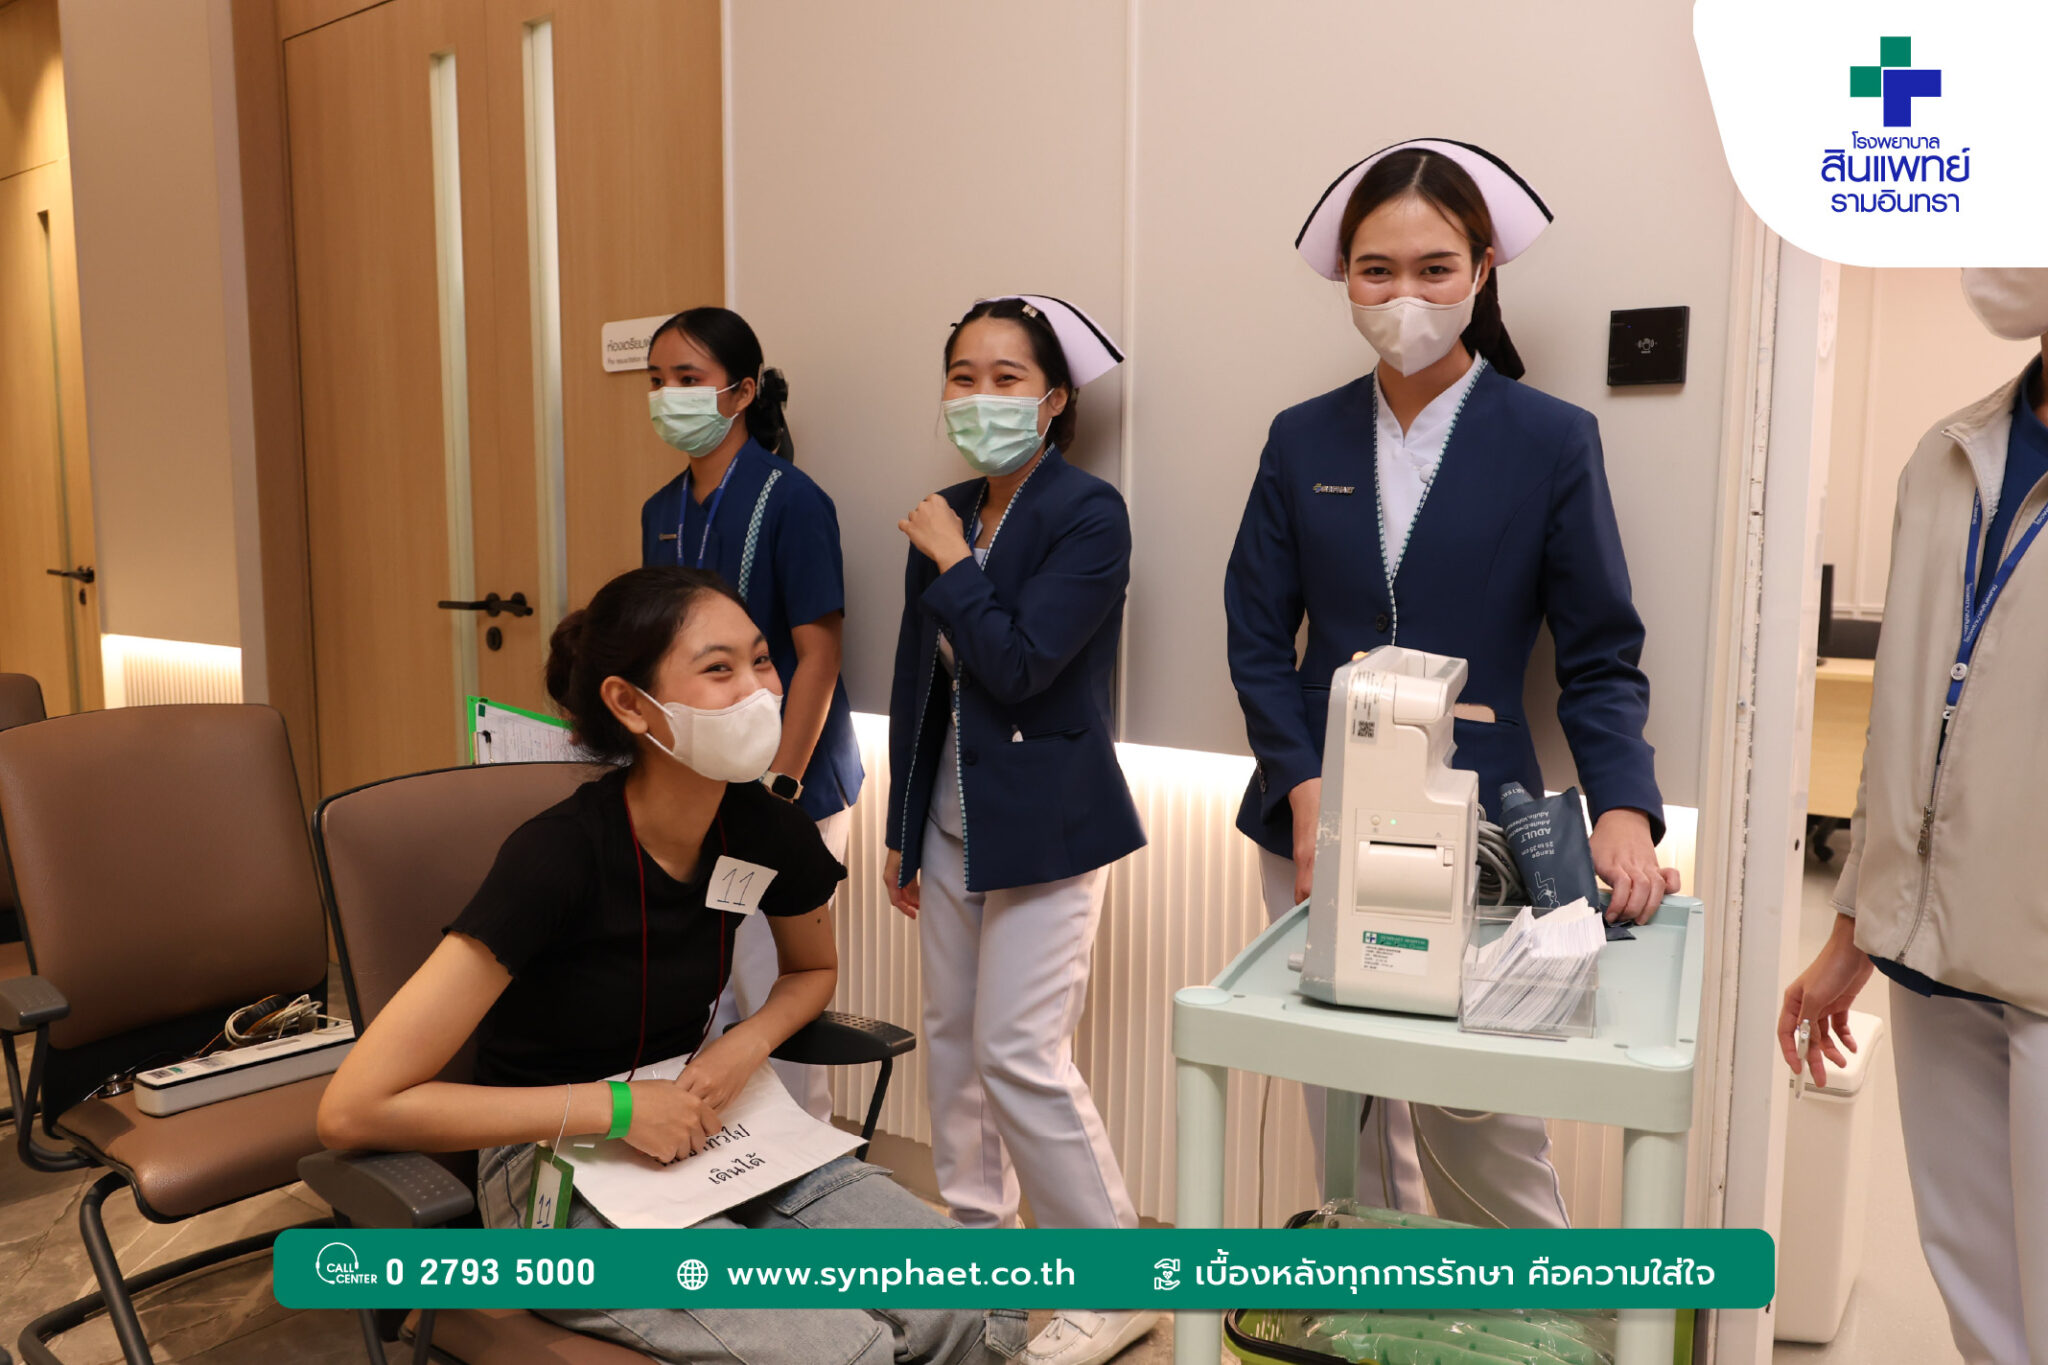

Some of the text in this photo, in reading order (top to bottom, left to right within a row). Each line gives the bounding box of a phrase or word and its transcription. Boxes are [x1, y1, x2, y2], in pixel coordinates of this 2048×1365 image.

[1520, 827, 1552, 843] ADULT
[717, 867, 755, 906] 11
[708, 1152, 766, 1185] เดินได้
